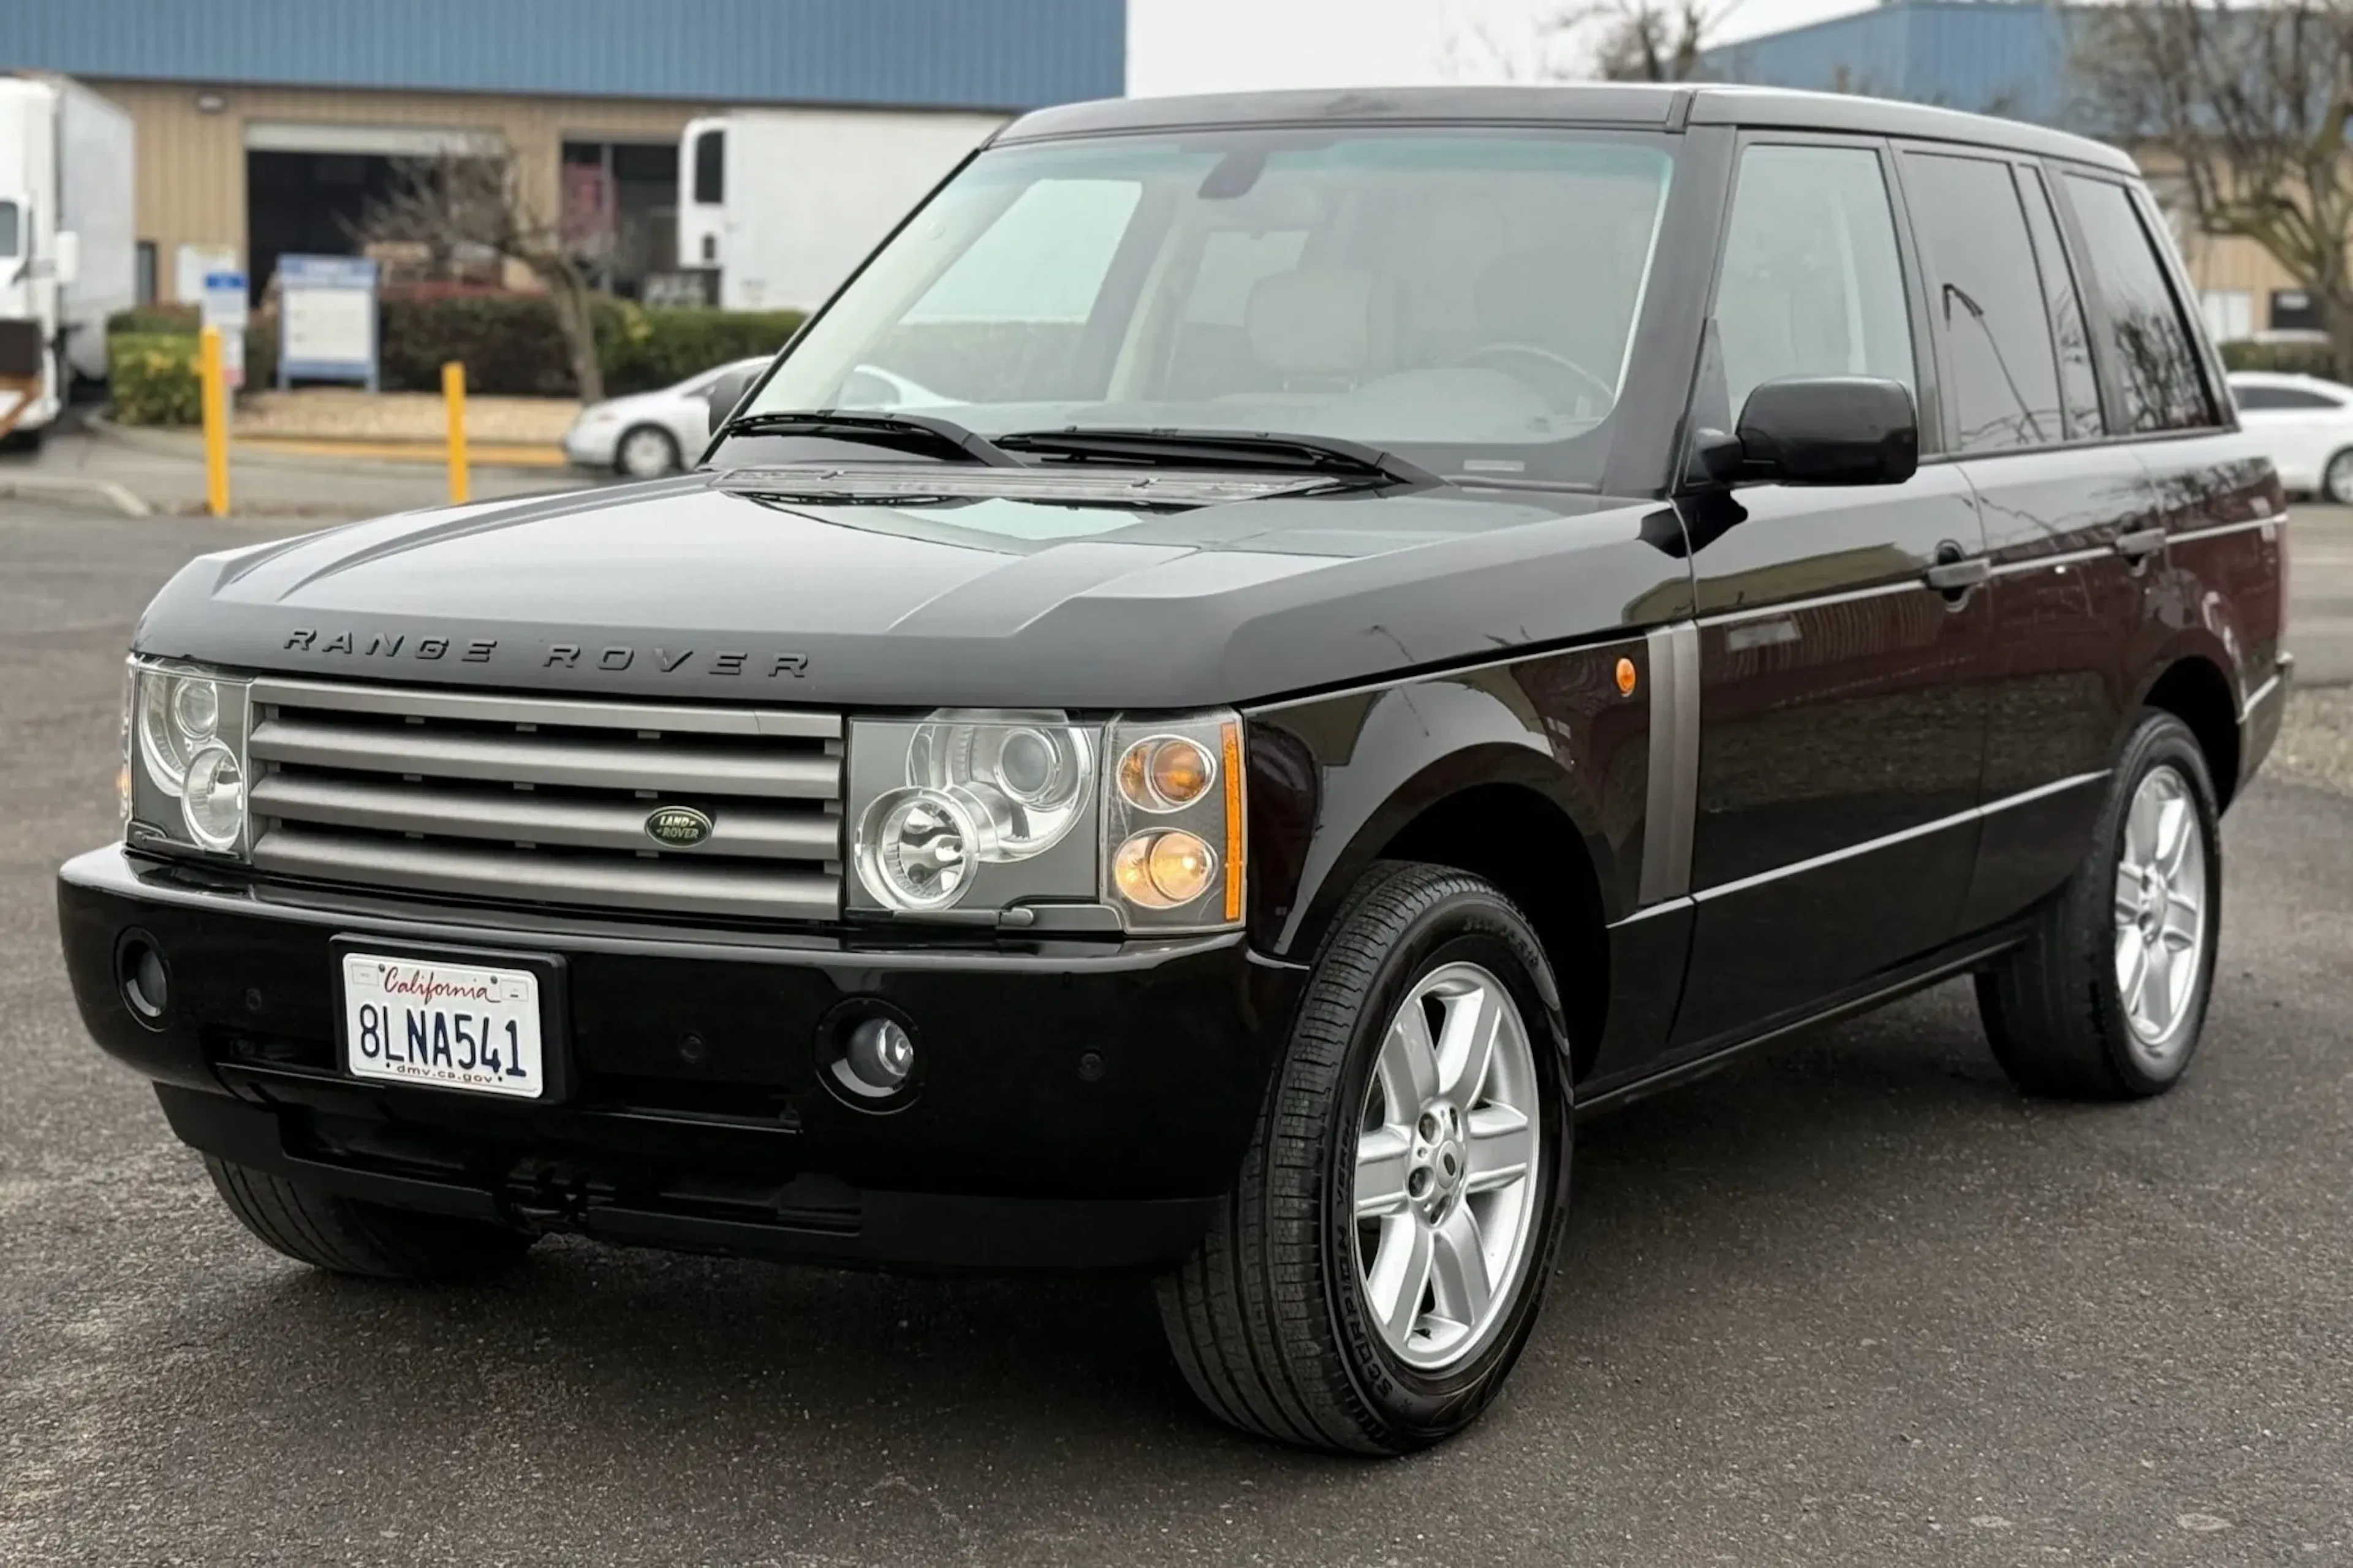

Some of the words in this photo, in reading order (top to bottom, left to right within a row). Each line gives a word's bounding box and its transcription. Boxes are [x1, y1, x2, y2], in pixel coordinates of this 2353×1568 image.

[284, 627, 498, 662] RANGE
[542, 643, 808, 678] ROVER
[384, 966, 501, 1004] California
[360, 1004, 526, 1077] 8LNA541
[397, 1064, 493, 1083] dmv.ca.gov
[1336, 1225, 1393, 1397] SCORPION
